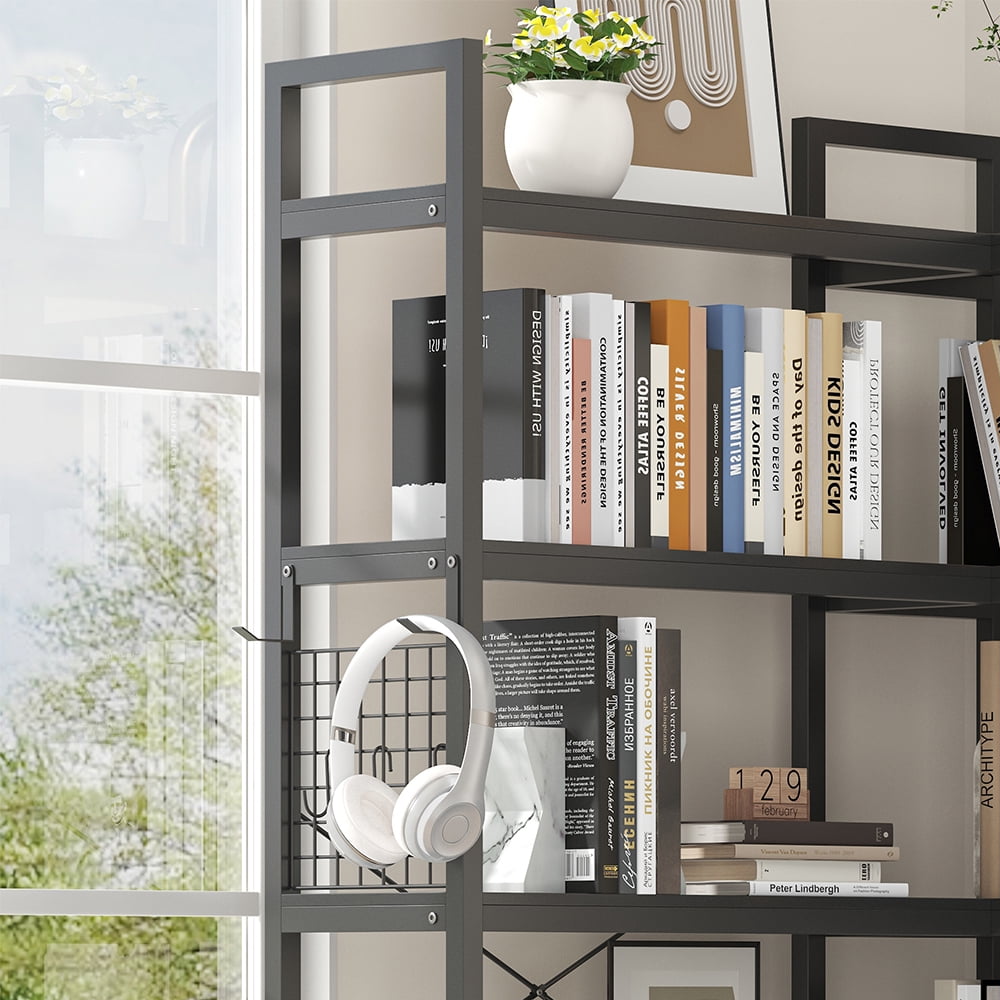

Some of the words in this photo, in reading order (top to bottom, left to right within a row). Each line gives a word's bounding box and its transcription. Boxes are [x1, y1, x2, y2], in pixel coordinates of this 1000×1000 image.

[624, 678, 634, 750] ИЗБРАННОЕ
[645, 725, 652, 745] НА
[981, 712, 993, 808] ARCHITYPE
[761, 805, 798, 817] february
[770, 884, 792, 892] Peter
[795, 885, 839, 895] Lindbergh
